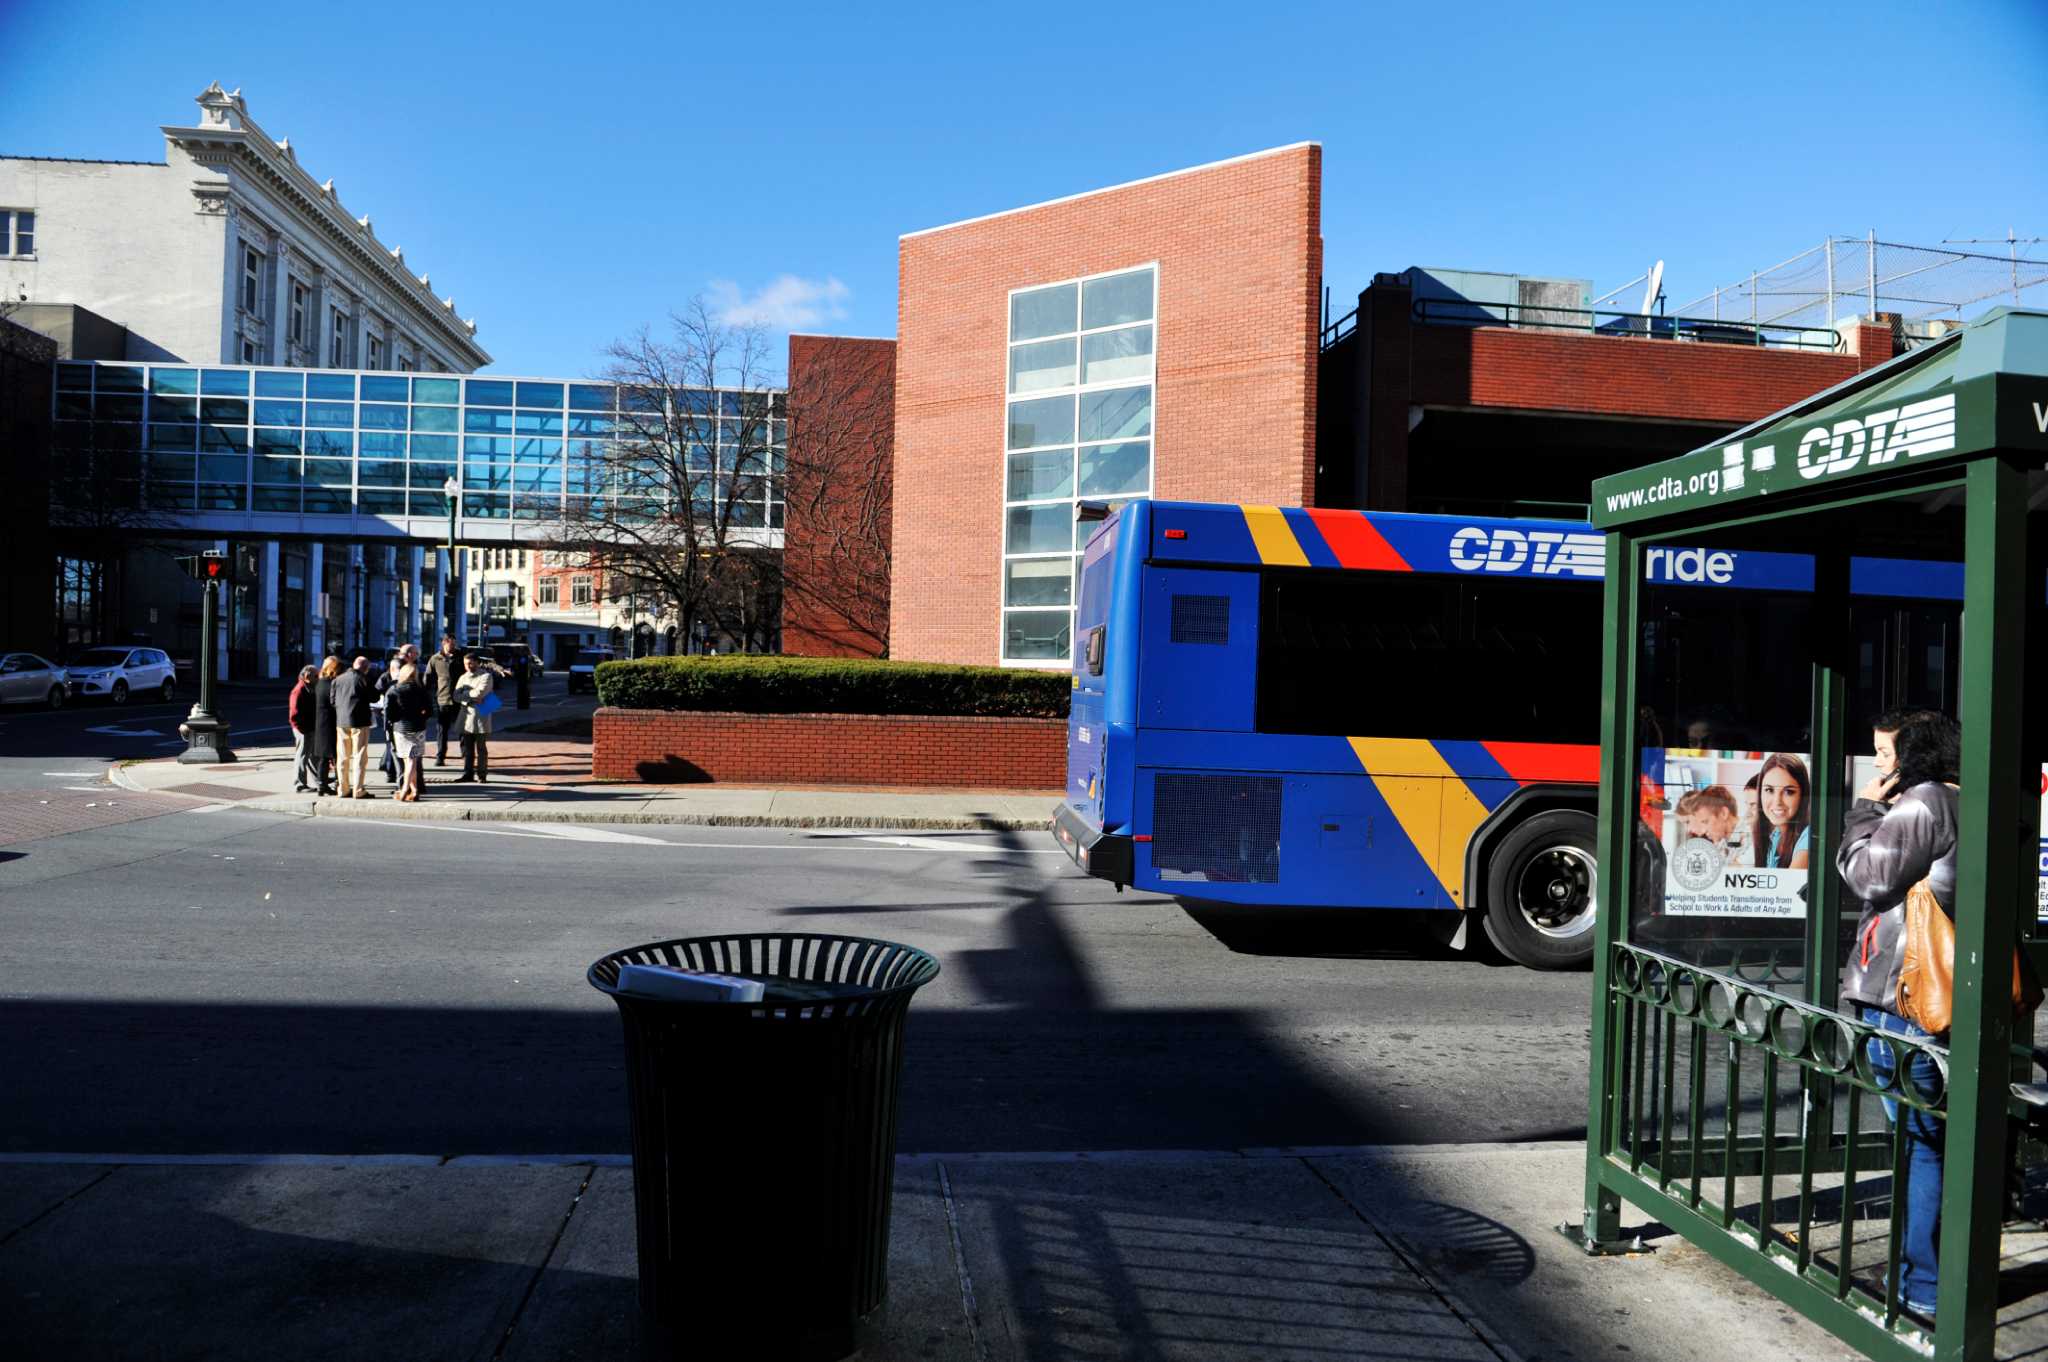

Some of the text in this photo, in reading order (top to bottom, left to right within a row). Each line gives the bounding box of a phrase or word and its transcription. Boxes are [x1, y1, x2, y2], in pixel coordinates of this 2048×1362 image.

[1606, 470, 1719, 513] www.cdta.org
[1797, 393, 1956, 479] CDTA
[1449, 527, 1606, 577] CDTA
[1725, 874, 1778, 889] NYSED
[1670, 894, 1792, 905] Helping Students Transitioning from
[1670, 903, 1693, 911] School
[1695, 904, 1702, 912] to
[1704, 904, 1721, 912] Work
[1763, 906, 1776, 914] Any
[1778, 906, 1792, 915] Age
